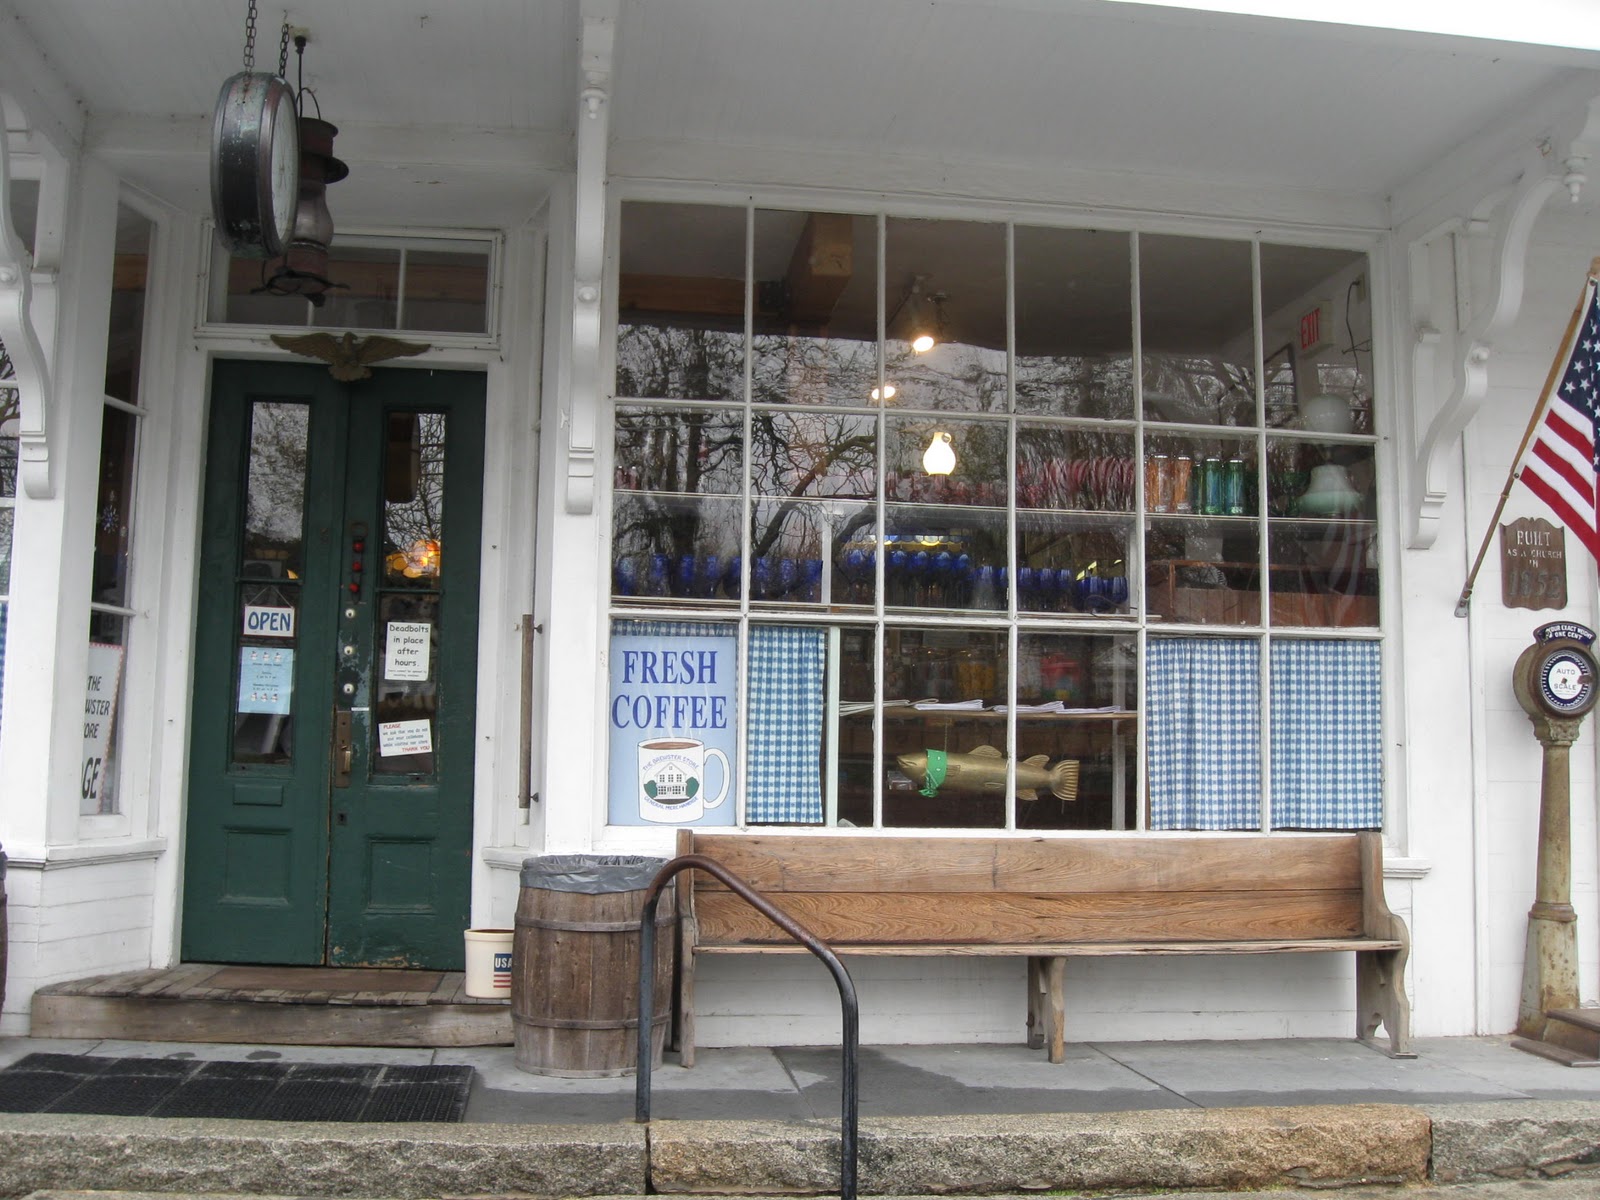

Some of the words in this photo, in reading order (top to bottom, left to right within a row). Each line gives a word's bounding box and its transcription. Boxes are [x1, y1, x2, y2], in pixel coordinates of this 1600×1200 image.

[1301, 307, 1320, 349] EXIT
[1517, 530, 1551, 546] BUILT
[1507, 548, 1518, 557] AS
[1531, 549, 1562, 559] CHURCH
[247, 611, 291, 632] OPEN
[389, 624, 429, 633] Deadbolts
[1561, 624, 1577, 633] EXACT
[403, 636, 424, 645] place
[1567, 631, 1583, 640] CENT
[397, 647, 419, 655] after
[394, 658, 420, 667] hours.
[622, 650, 718, 685] FRESH
[1556, 668, 1576, 676] AUTO
[87, 676, 102, 692] THE
[1553, 683, 1577, 691] SCALE
[85, 699, 111, 716] WSTER
[611, 694, 728, 729] COFFEE
[643, 761, 653, 771] THE
[652, 754, 682, 764] BREWSTER
[682, 756, 700, 770] STORE
[644, 795, 665, 810] GENERAL
[665, 796, 699, 811] MERCHANDISE
[495, 957, 513, 968] USA
